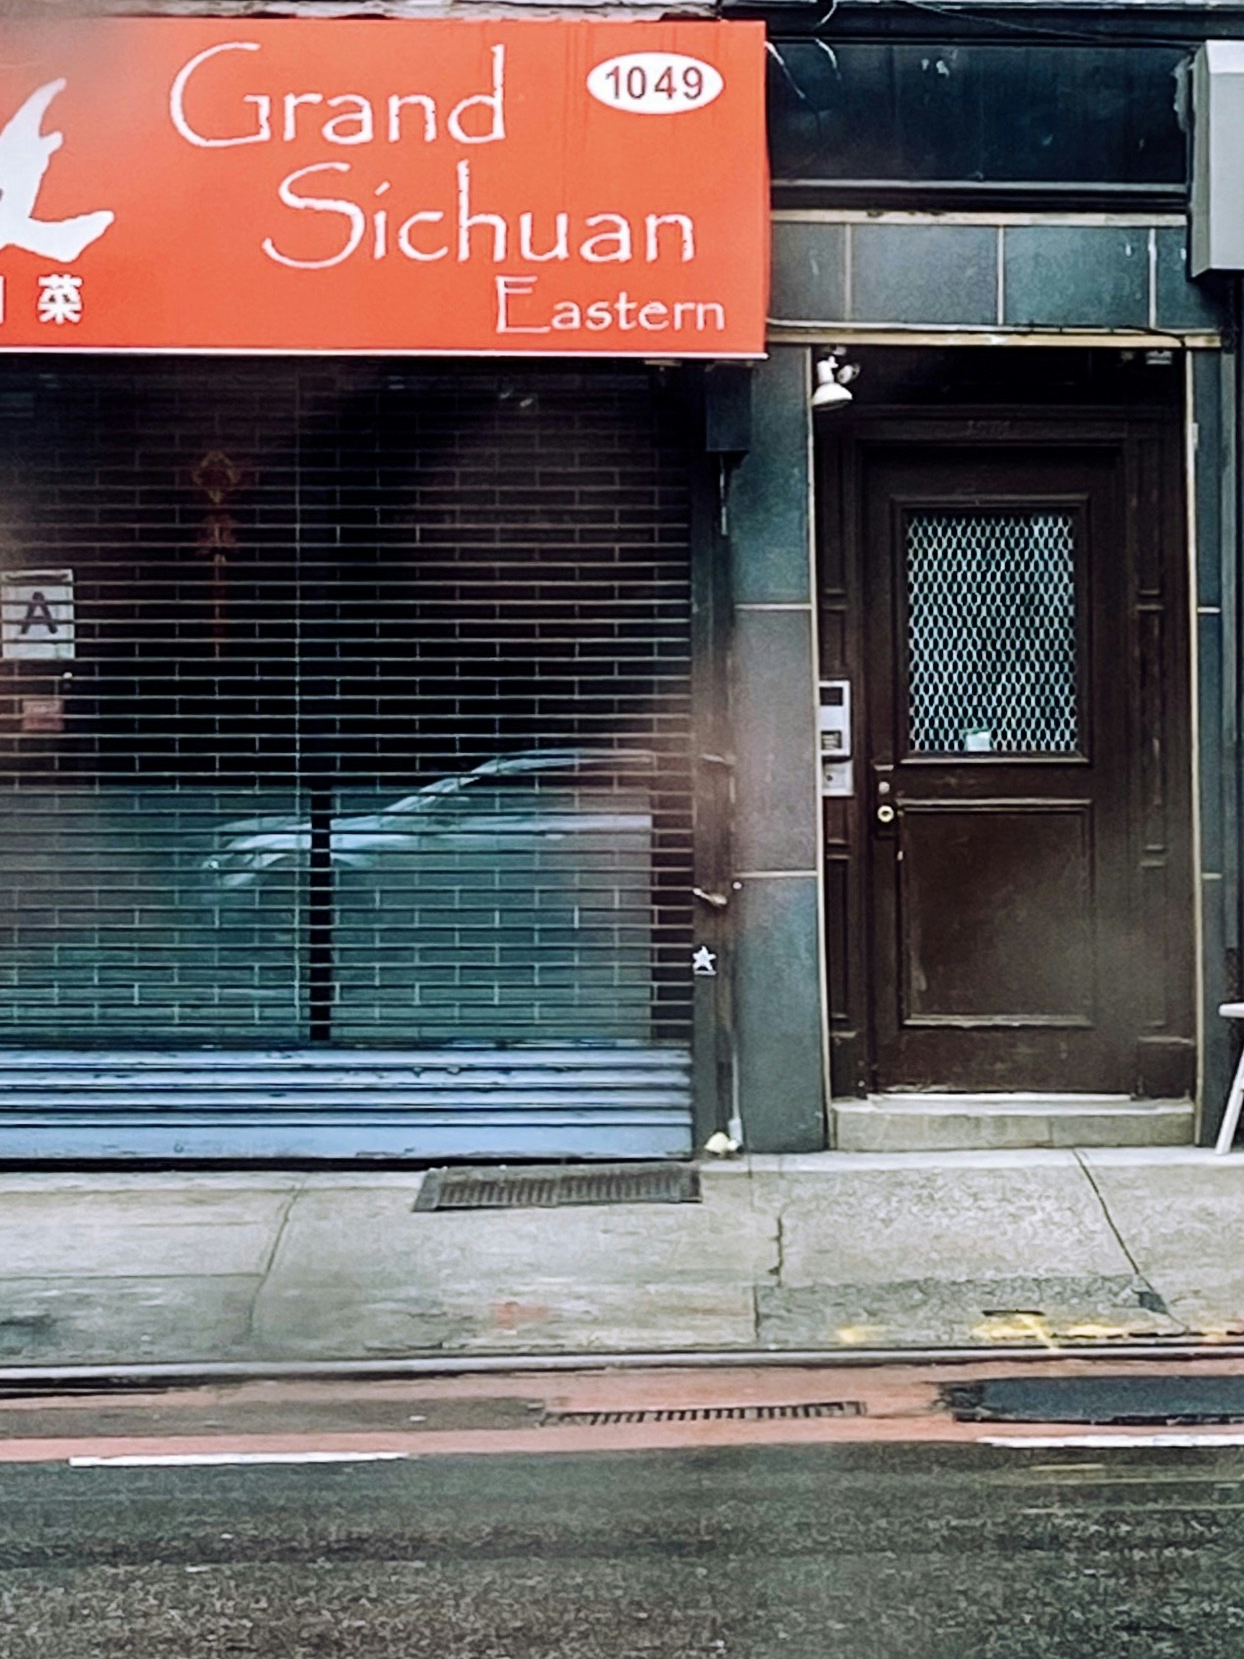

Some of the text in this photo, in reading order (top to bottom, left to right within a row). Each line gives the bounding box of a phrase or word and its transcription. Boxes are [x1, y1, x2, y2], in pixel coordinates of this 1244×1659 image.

[169, 42, 505, 147] Grand
[604, 65, 705, 100] 1049
[262, 160, 694, 269] Sichuan
[496, 276, 725, 333] Eastern
[20, 591, 58, 635] A
